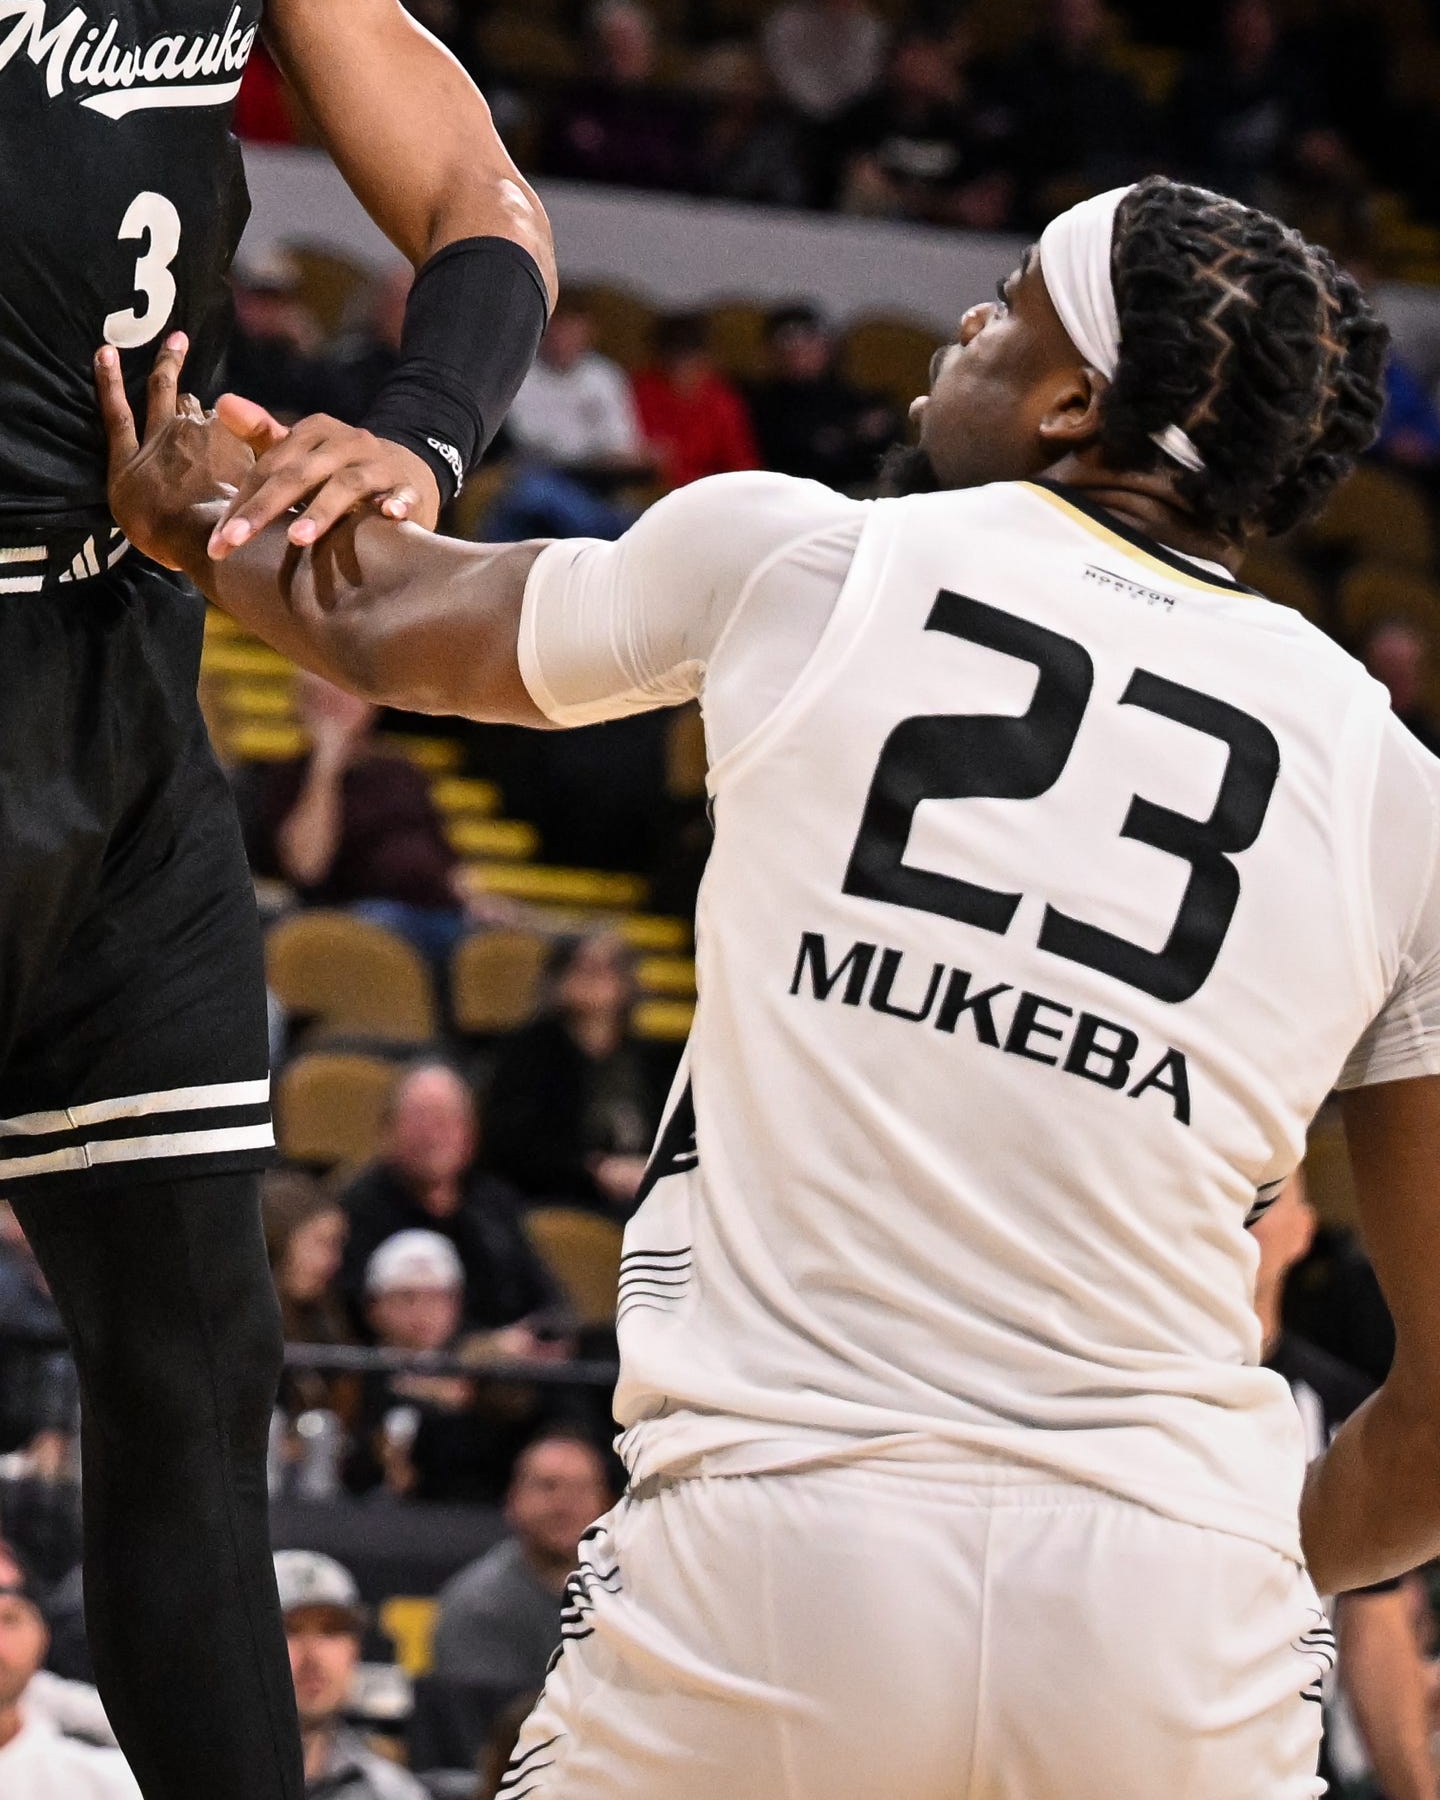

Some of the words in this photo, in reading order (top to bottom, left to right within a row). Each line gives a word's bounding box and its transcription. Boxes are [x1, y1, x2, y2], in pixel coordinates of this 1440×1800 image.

[103, 191, 181, 348] 3
[841, 588, 1280, 1004] 23
[789, 931, 1191, 1127] MUKEBA
